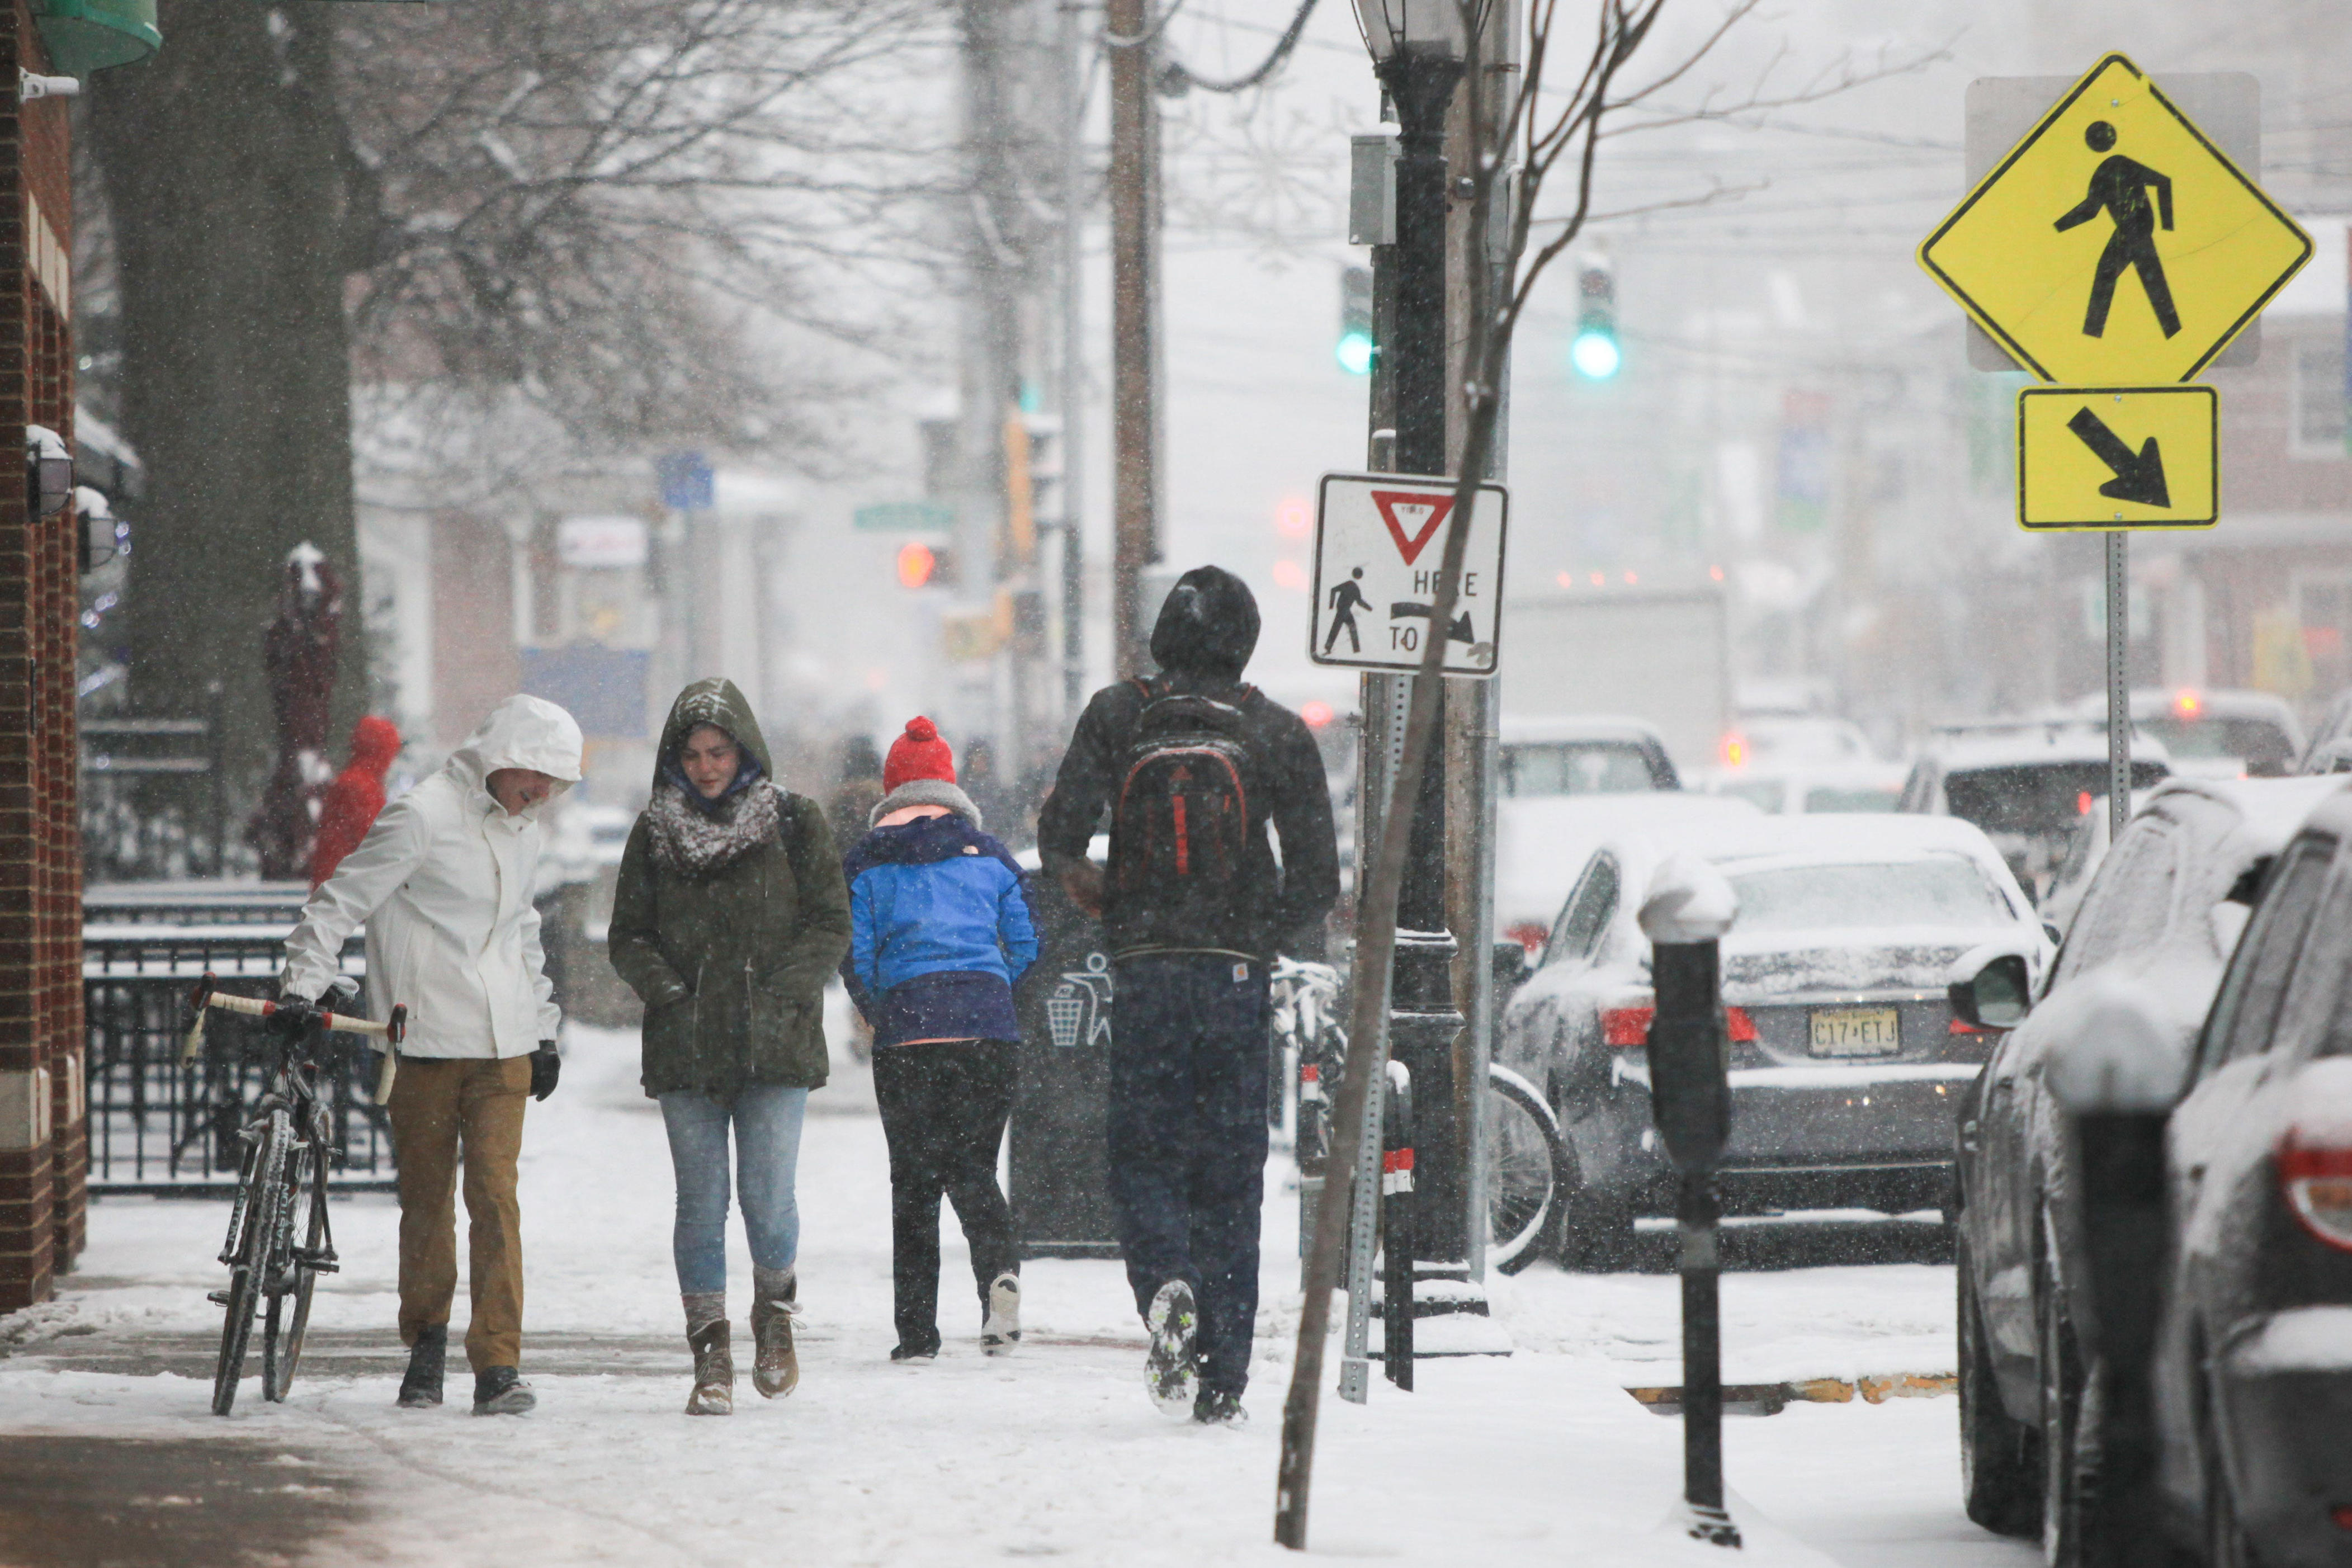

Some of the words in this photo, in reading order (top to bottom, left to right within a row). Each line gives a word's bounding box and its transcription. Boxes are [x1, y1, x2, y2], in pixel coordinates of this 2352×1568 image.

[1401, 505, 1424, 514] YID
[1414, 570, 1477, 596] HEE
[1390, 626, 1418, 651] TO
[227, 1176, 250, 1241] EASTON
[276, 1183, 289, 1250] EASTON
